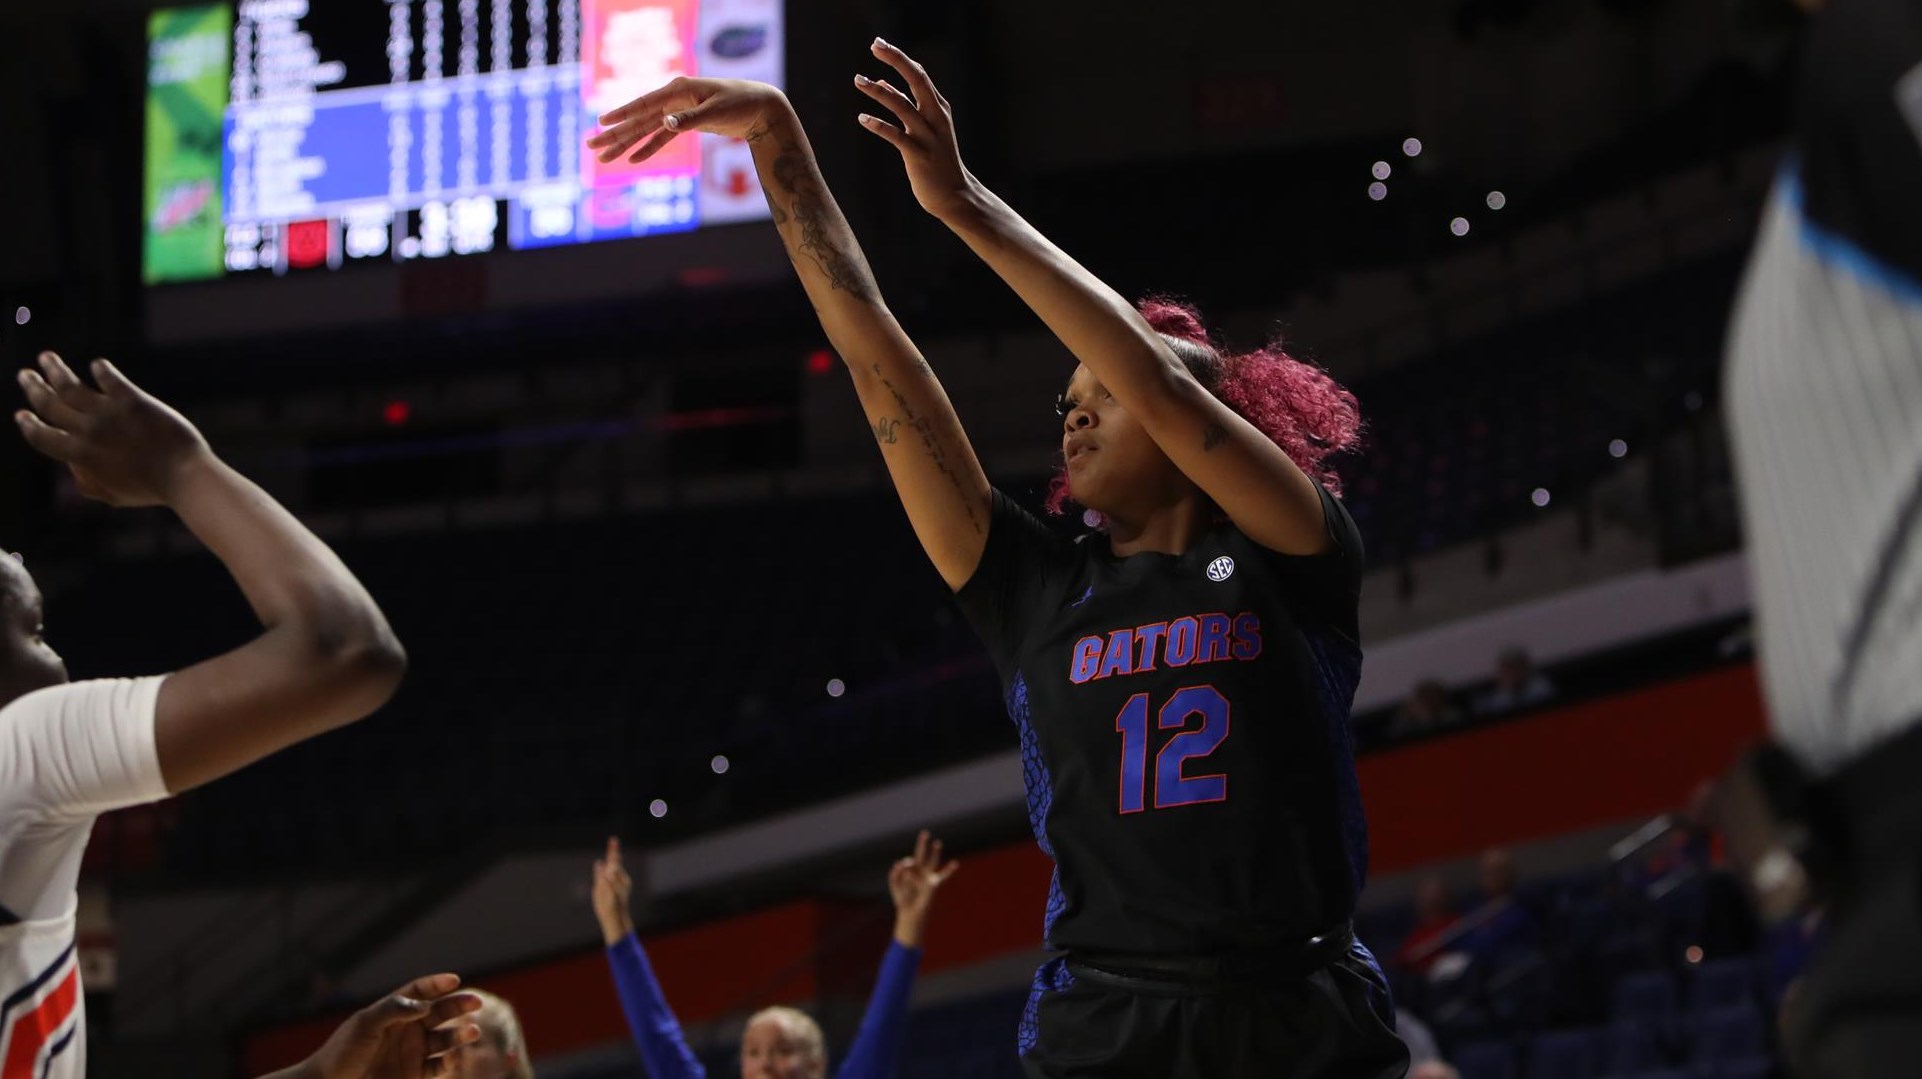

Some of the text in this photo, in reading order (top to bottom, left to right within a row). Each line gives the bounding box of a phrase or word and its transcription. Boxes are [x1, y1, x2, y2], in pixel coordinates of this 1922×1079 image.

[1209, 558, 1232, 579] SEC
[1069, 612, 1262, 685] GATORS
[1116, 684, 1230, 814] 12
